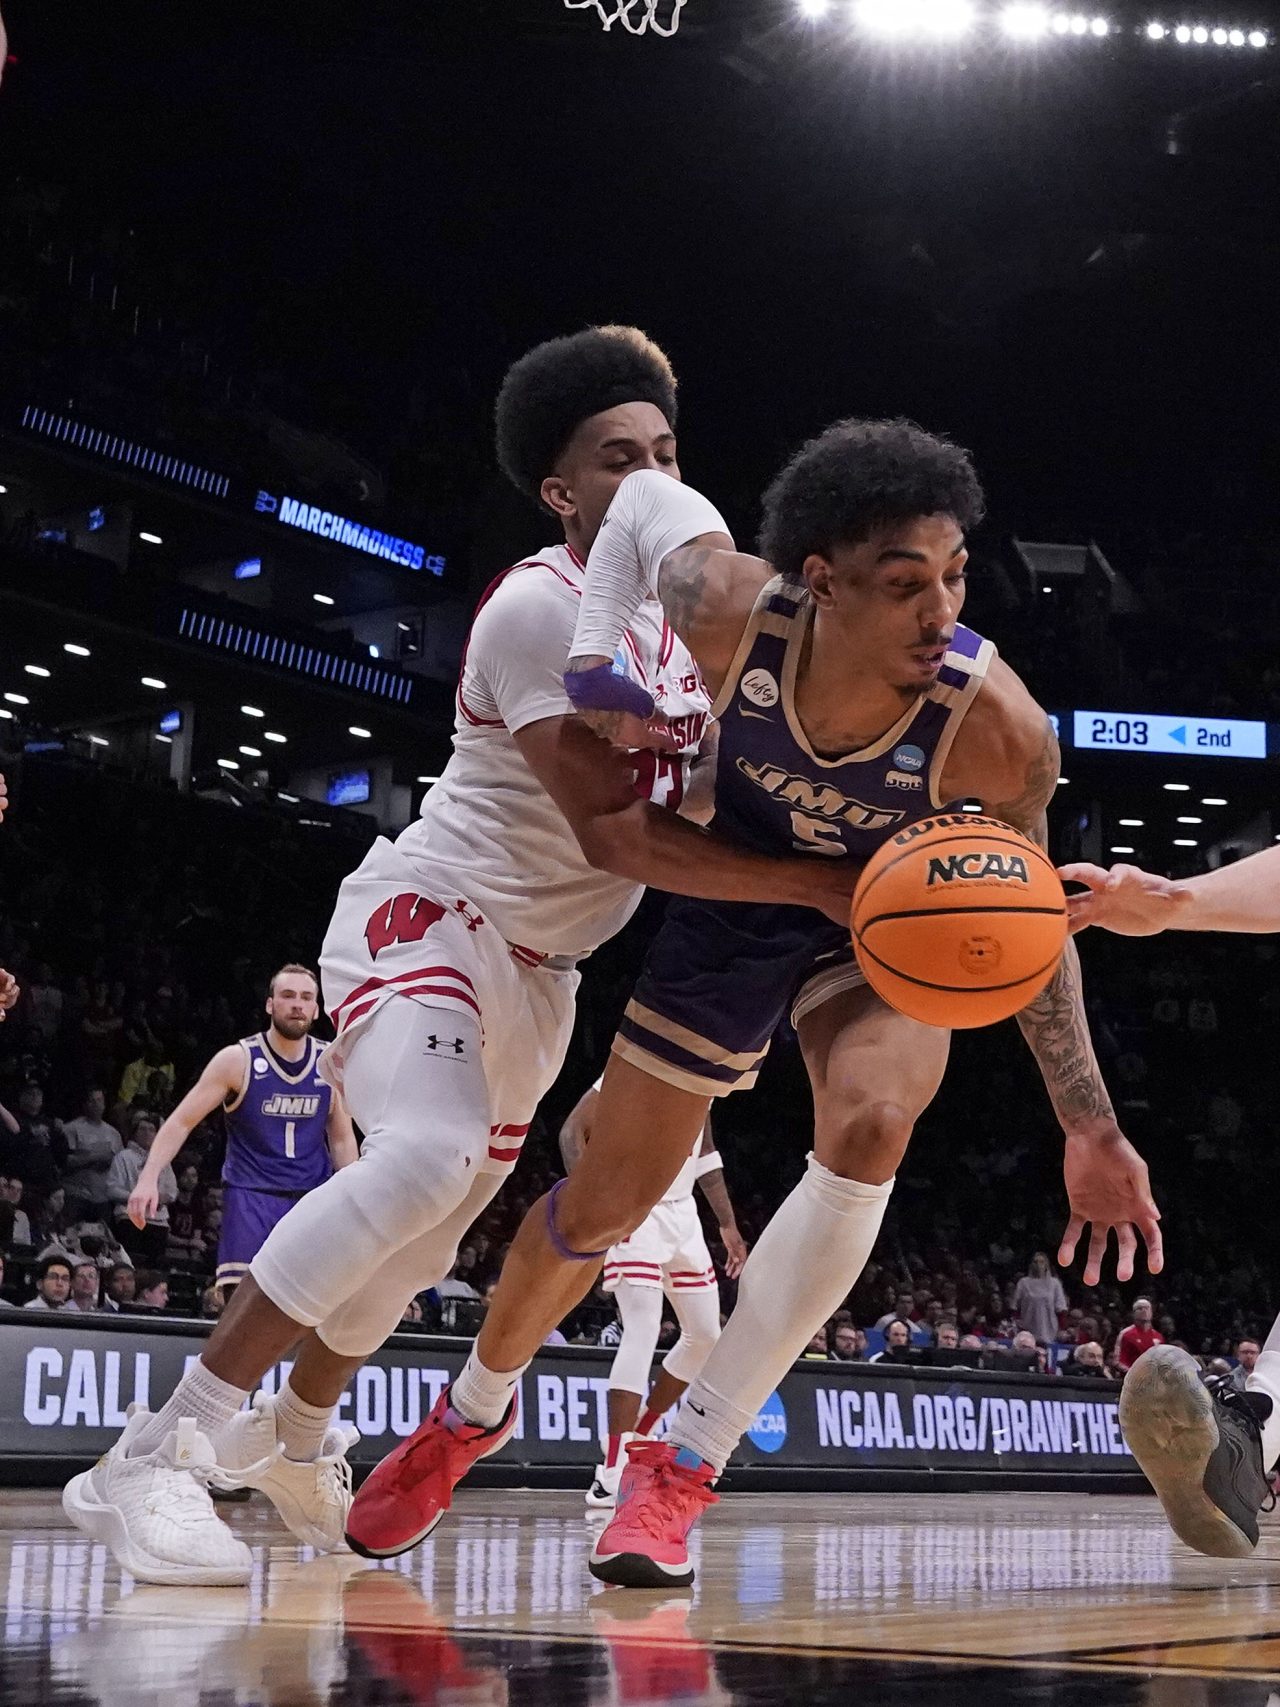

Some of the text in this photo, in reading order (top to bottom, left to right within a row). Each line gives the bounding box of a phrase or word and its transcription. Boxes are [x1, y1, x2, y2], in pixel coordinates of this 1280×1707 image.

[1091, 718, 1149, 746] 2:03
[1196, 727, 1231, 748] 2nd
[735, 757, 906, 830] JMU
[927, 854, 1028, 886] NCAA
[262, 1094, 321, 1117] JMU
[285, 1121, 296, 1158] 1
[23, 1347, 151, 1427] CALL
[816, 1389, 1133, 1455] NCAA.ORG/DRAWTHE
